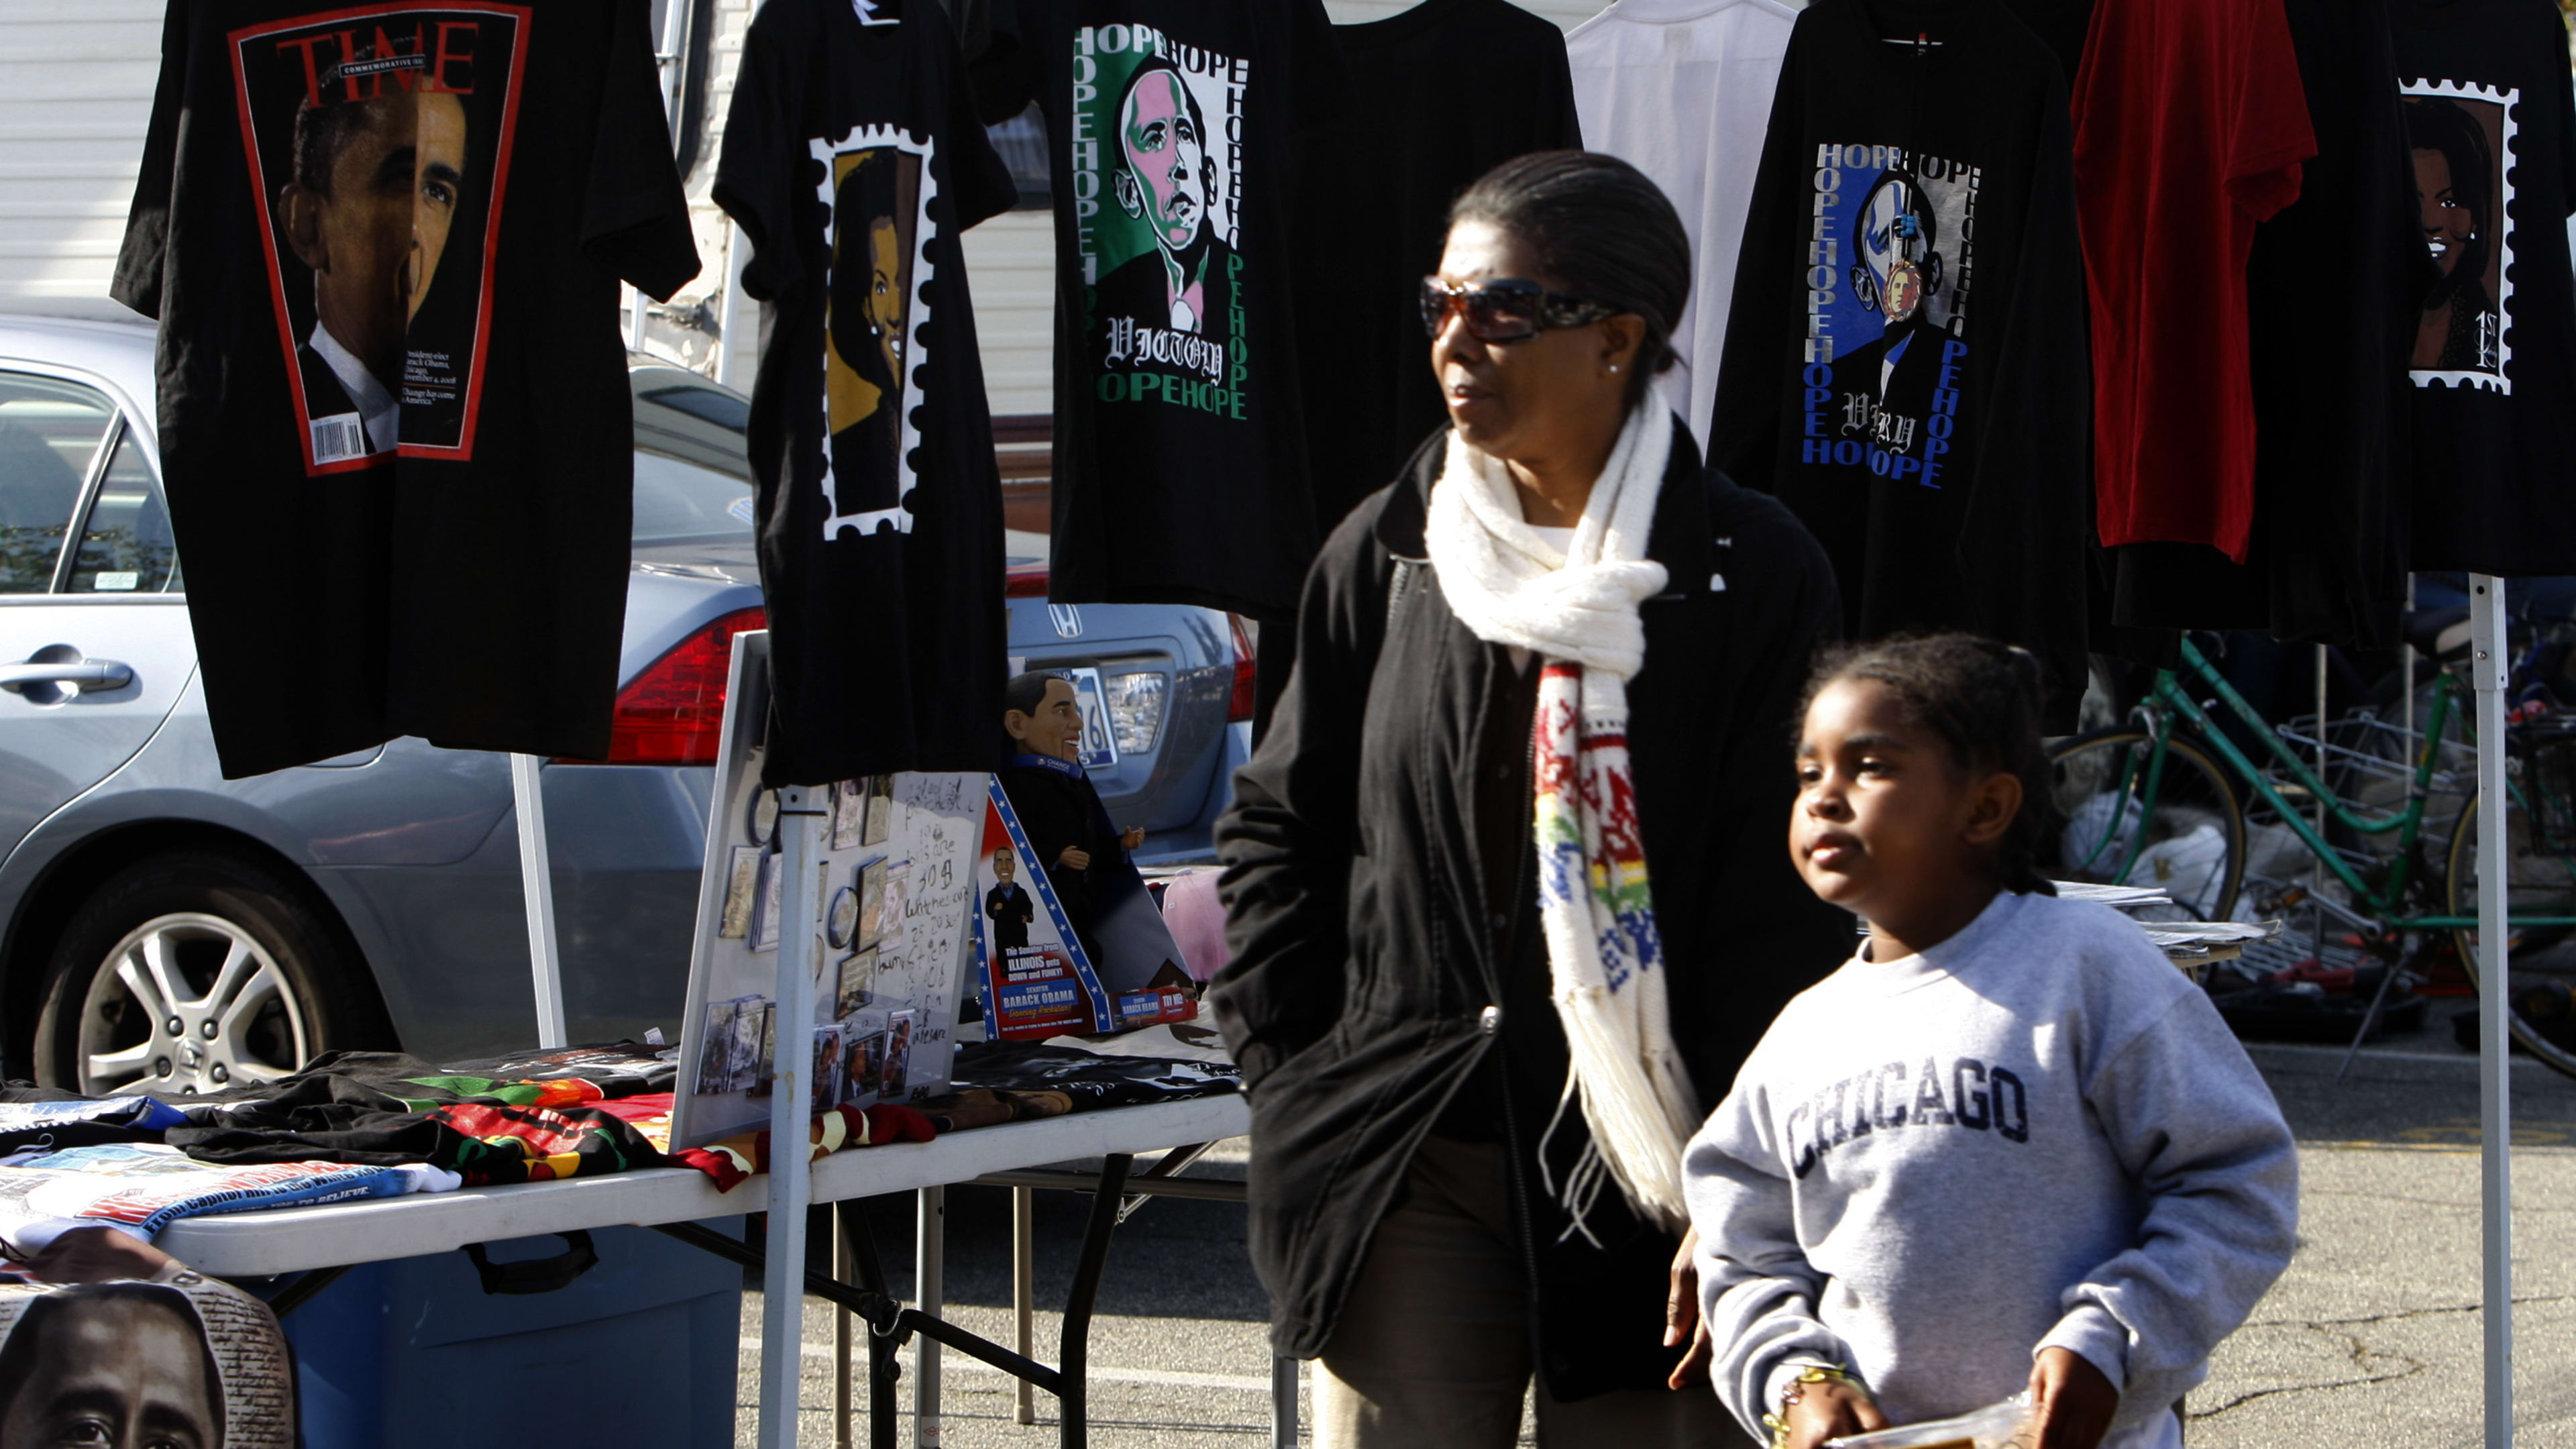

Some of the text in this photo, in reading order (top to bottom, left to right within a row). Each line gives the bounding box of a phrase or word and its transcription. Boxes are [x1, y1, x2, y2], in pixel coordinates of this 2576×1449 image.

[276, 22, 479, 109] TIME
[343, 59, 411, 74] COMMEMORATIVE
[1006, 943, 1060, 957] The Senator from
[1008, 956, 1061, 972] ILLINOIS gets
[1008, 971, 1028, 982] DOWN
[1028, 970, 1040, 979] and
[1026, 985, 1049, 994] SENATOR
[1003, 989, 1074, 1008] BARACK OBAMA
[1010, 1008, 1038, 1019] Dancing
[1787, 1055, 2029, 1180] CHICAGO
[318, 1186, 370, 1203] BELIEVE.
[142, 1199, 184, 1236] From
[185, 1189, 244, 1212] Capitol
[273, 1185, 287, 1195] to
[288, 1179, 313, 1193] the
[315, 1170, 355, 1187] White
